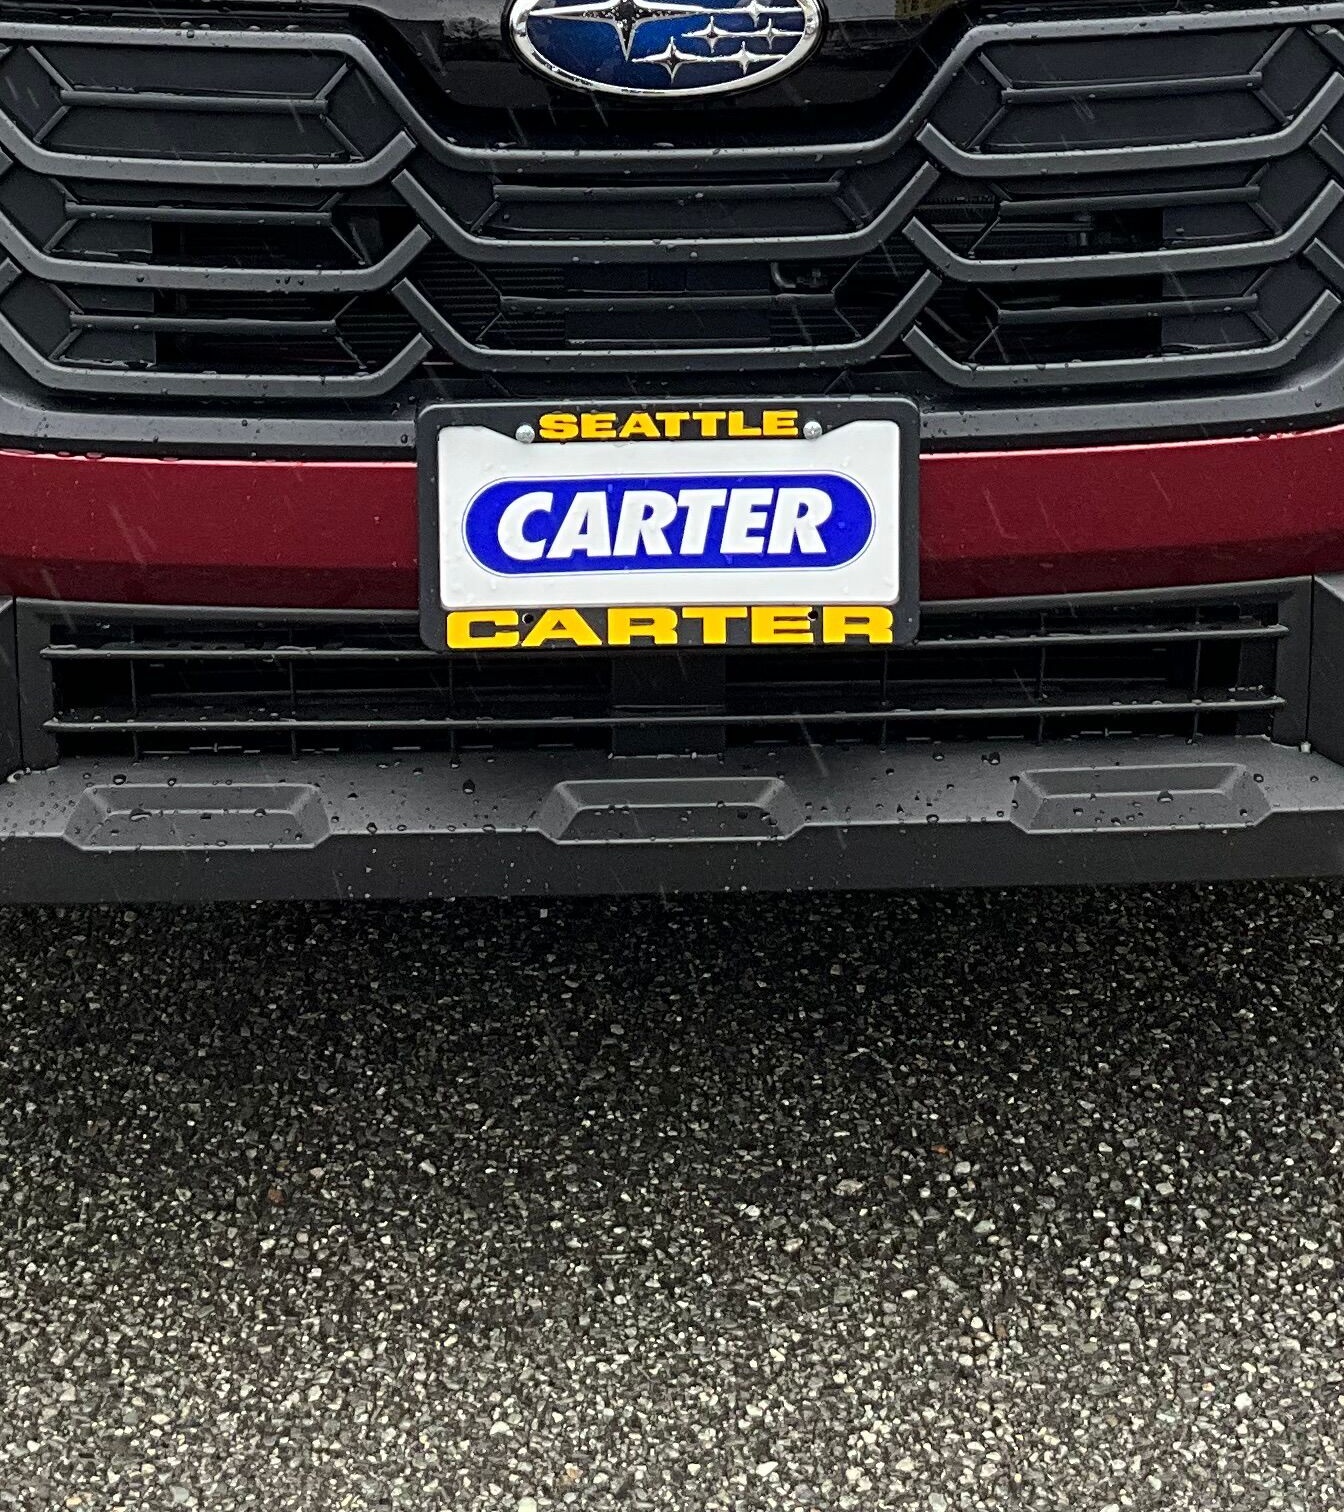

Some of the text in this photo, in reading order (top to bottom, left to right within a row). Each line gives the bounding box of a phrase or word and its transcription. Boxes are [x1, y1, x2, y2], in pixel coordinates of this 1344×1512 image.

[539, 410, 798, 439] SEATTLE
[497, 488, 832, 561] CARTER
[446, 607, 893, 649] CARTER
